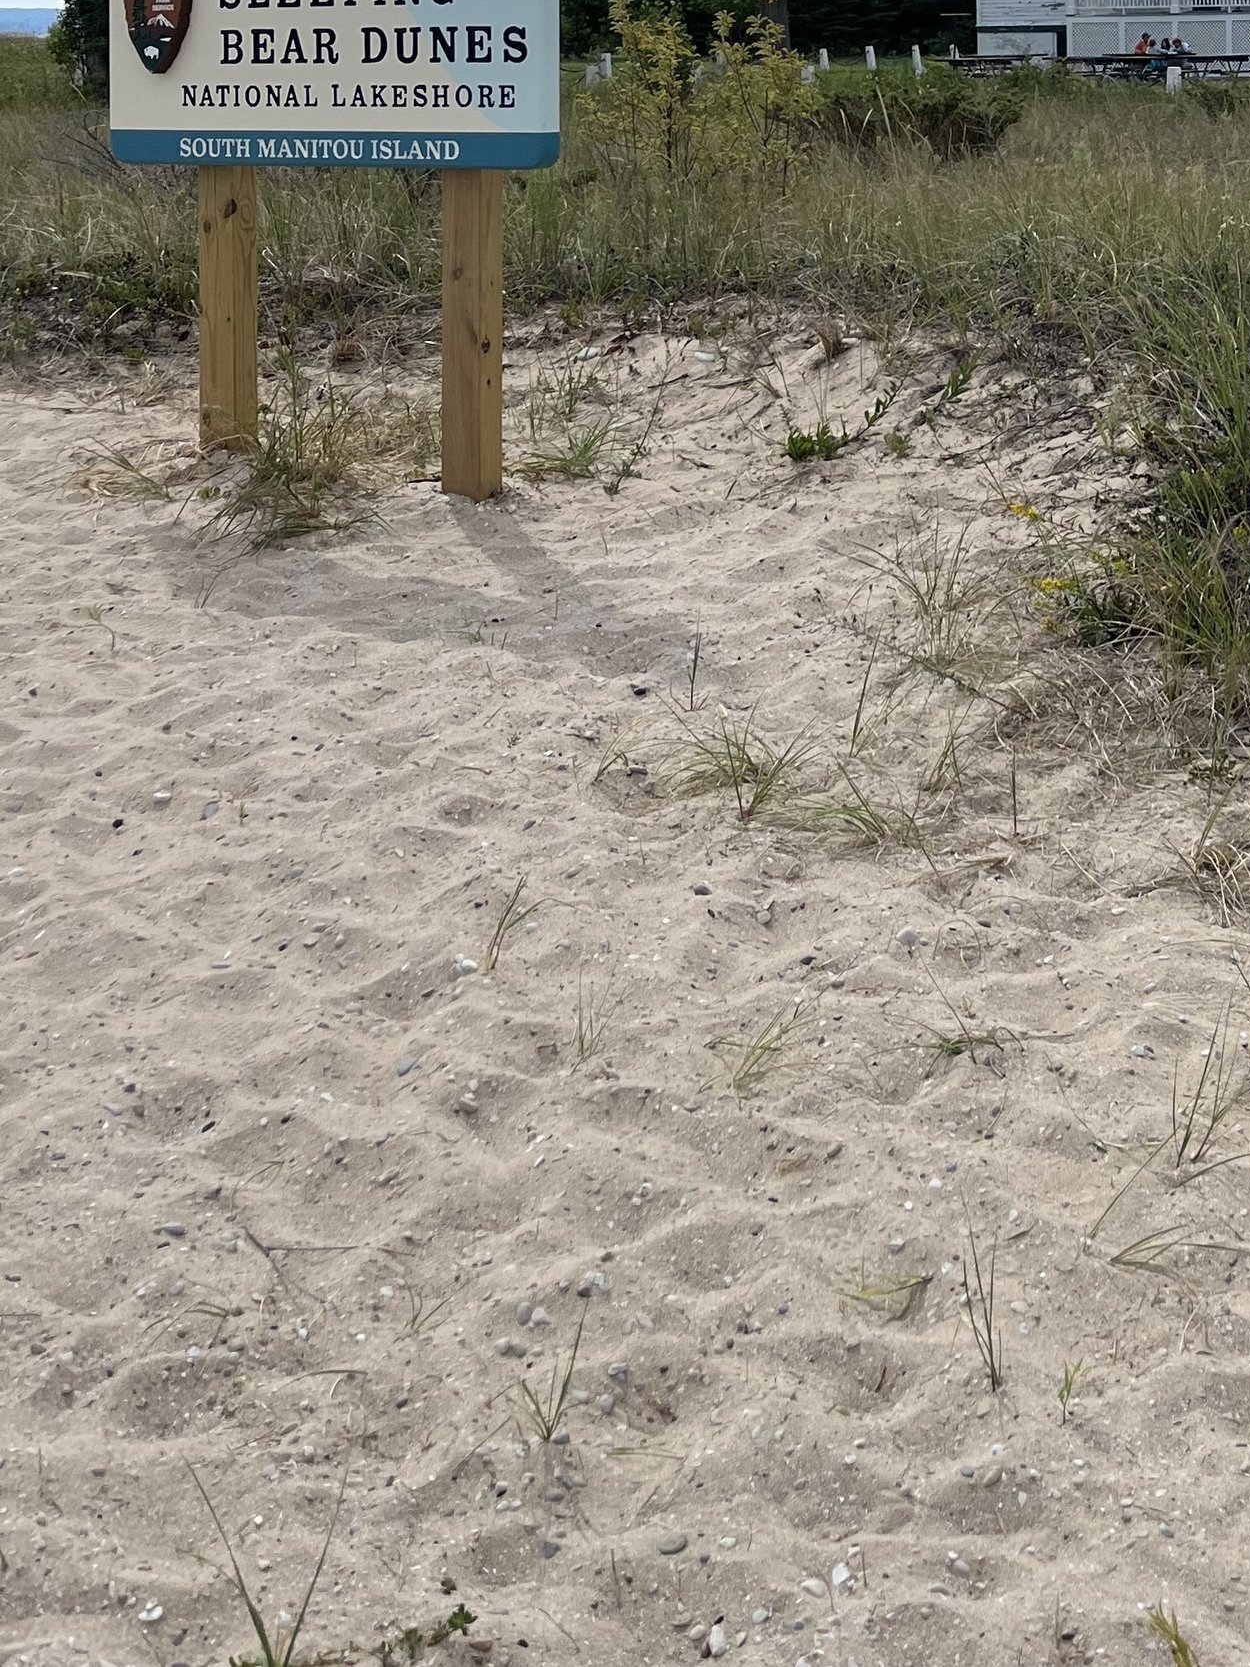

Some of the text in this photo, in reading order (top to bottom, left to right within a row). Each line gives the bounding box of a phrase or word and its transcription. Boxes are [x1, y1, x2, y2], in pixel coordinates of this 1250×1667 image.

[220, 26, 528, 65] BEAR DUNES
[182, 83, 516, 109] NATIONAL LAKESHORE
[180, 137, 460, 162] SOUTH MANITOU ISLAND
